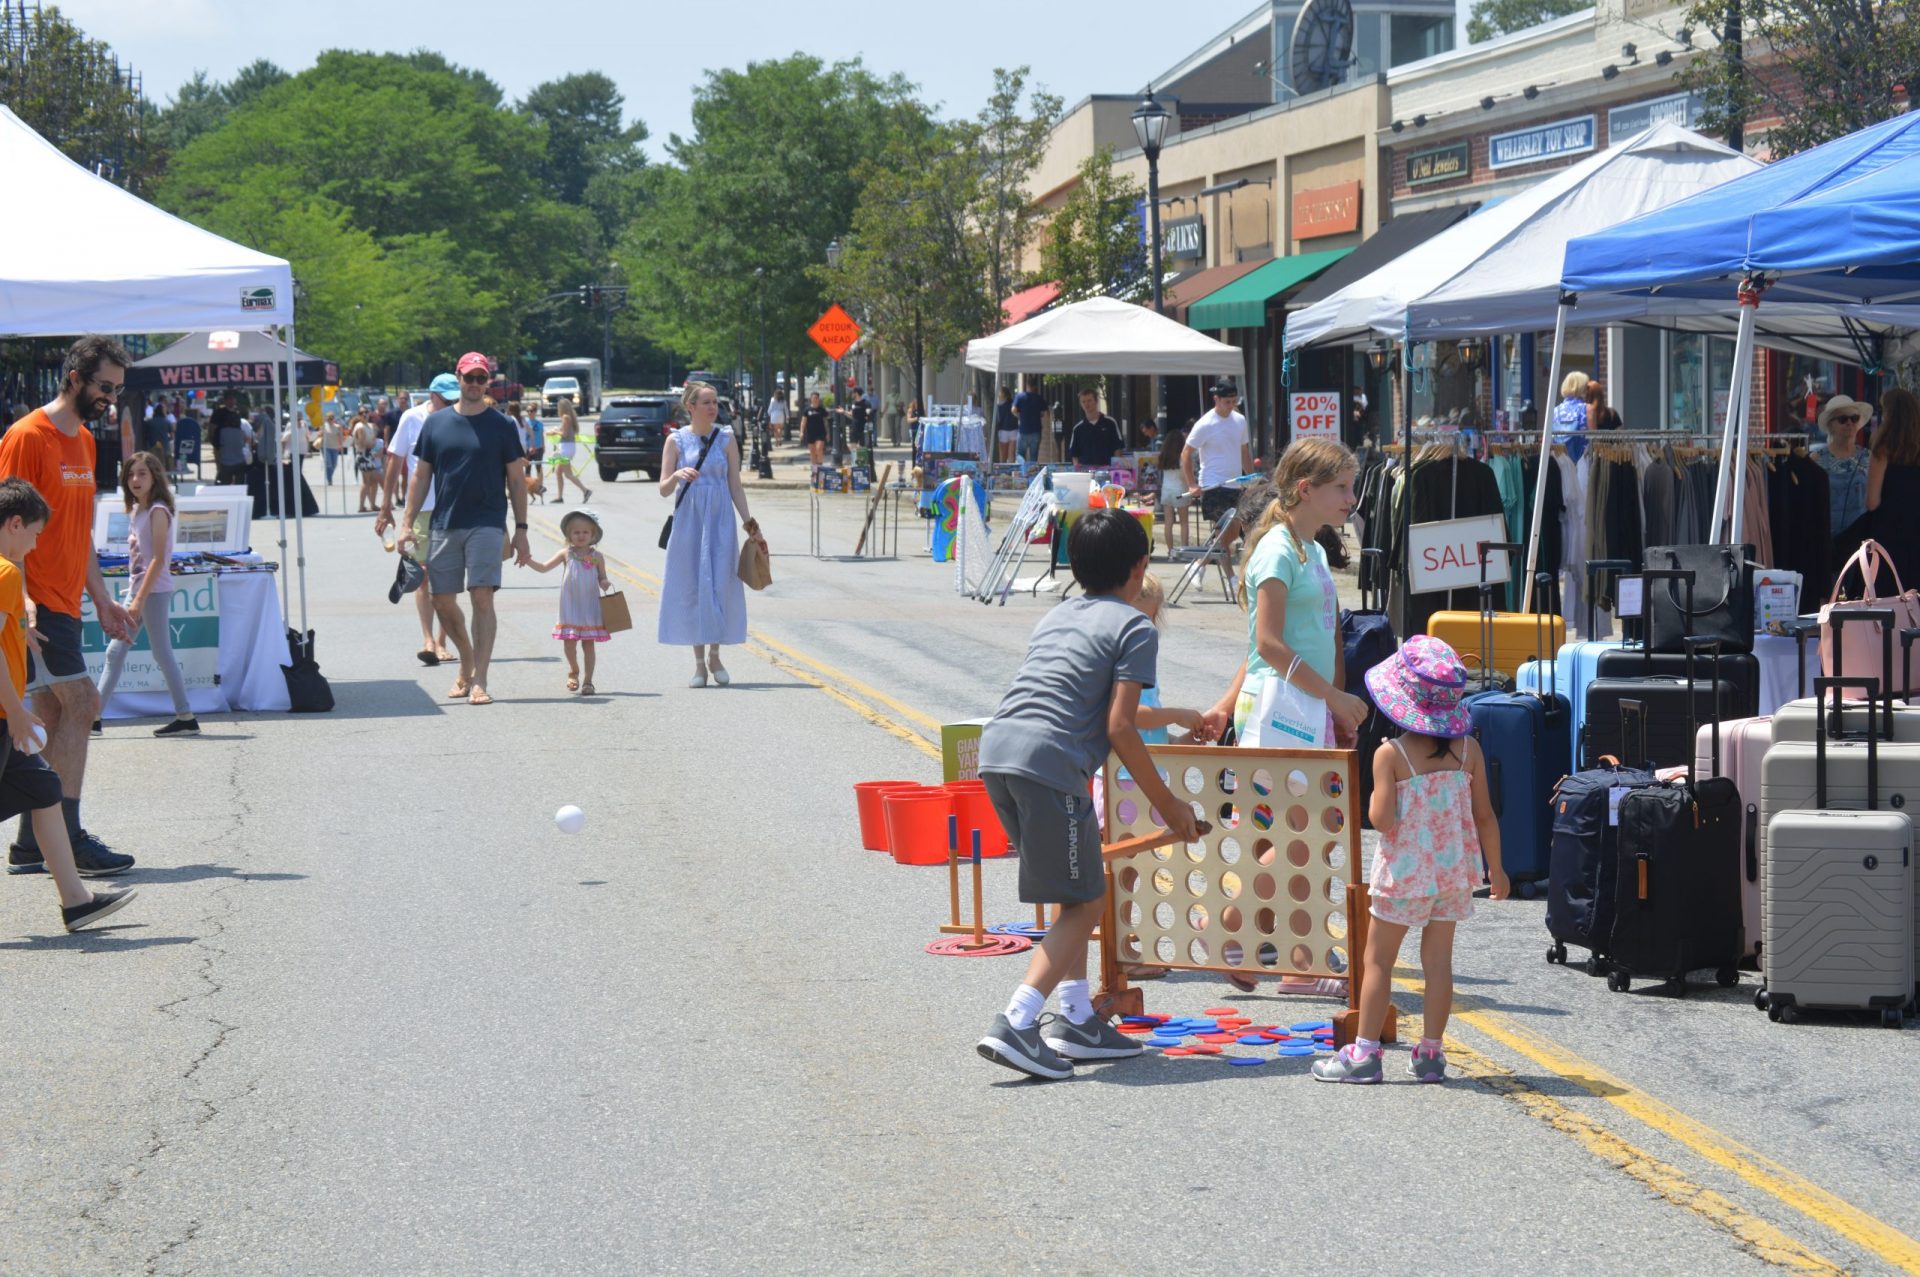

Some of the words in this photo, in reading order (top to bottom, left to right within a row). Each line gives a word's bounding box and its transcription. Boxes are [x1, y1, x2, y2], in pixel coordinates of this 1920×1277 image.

[1497, 131, 1543, 161] WELLESLEY
[1545, 127, 1563, 152] TOY
[1564, 122, 1587, 148] SHOP
[1176, 222, 1199, 252] LICKS
[820, 323, 852, 332] DETOUR
[822, 335, 851, 344] AHEAD
[159, 364, 275, 385] WELLESLEY
[1295, 396, 1337, 411] 20%
[1296, 415, 1336, 430] OFF
[1423, 540, 1494, 571] SALE
[1273, 710, 1317, 735] CleverHand
[957, 737, 980, 754] GIAN
[958, 751, 980, 769] YAR
[1068, 817, 1080, 880] ARMOUR
